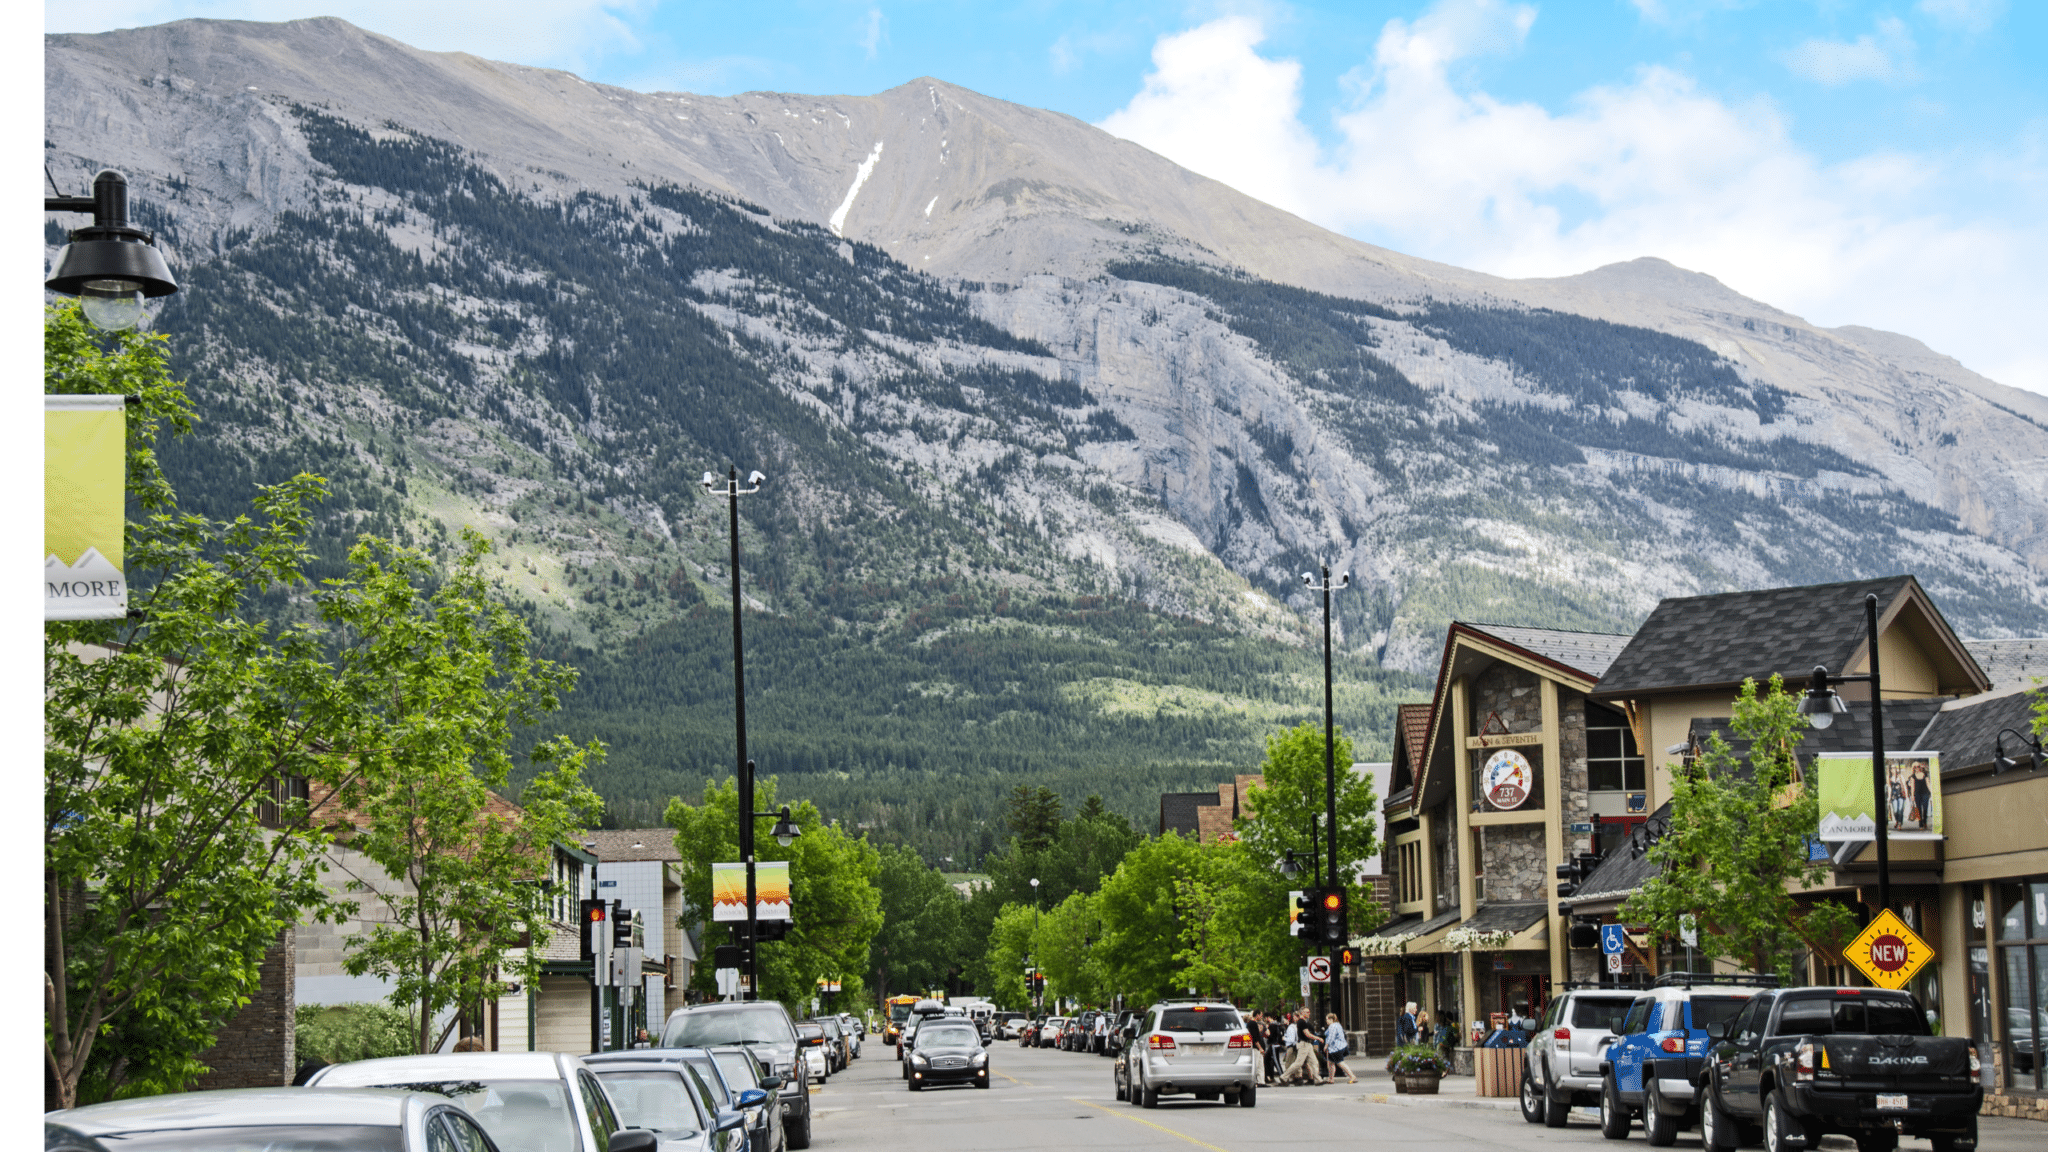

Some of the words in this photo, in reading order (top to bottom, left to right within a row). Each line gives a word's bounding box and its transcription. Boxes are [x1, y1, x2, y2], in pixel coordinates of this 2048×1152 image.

[47, 580, 121, 599] MORE
[1472, 738, 1493, 747] MAN
[1502, 735, 1537, 745] SEVENTH
[1500, 787, 1515, 797] 737
[1821, 825, 1873, 834] CANMORE
[1872, 944, 1905, 962] NEW
[1868, 1055, 1929, 1065] DAKINE
